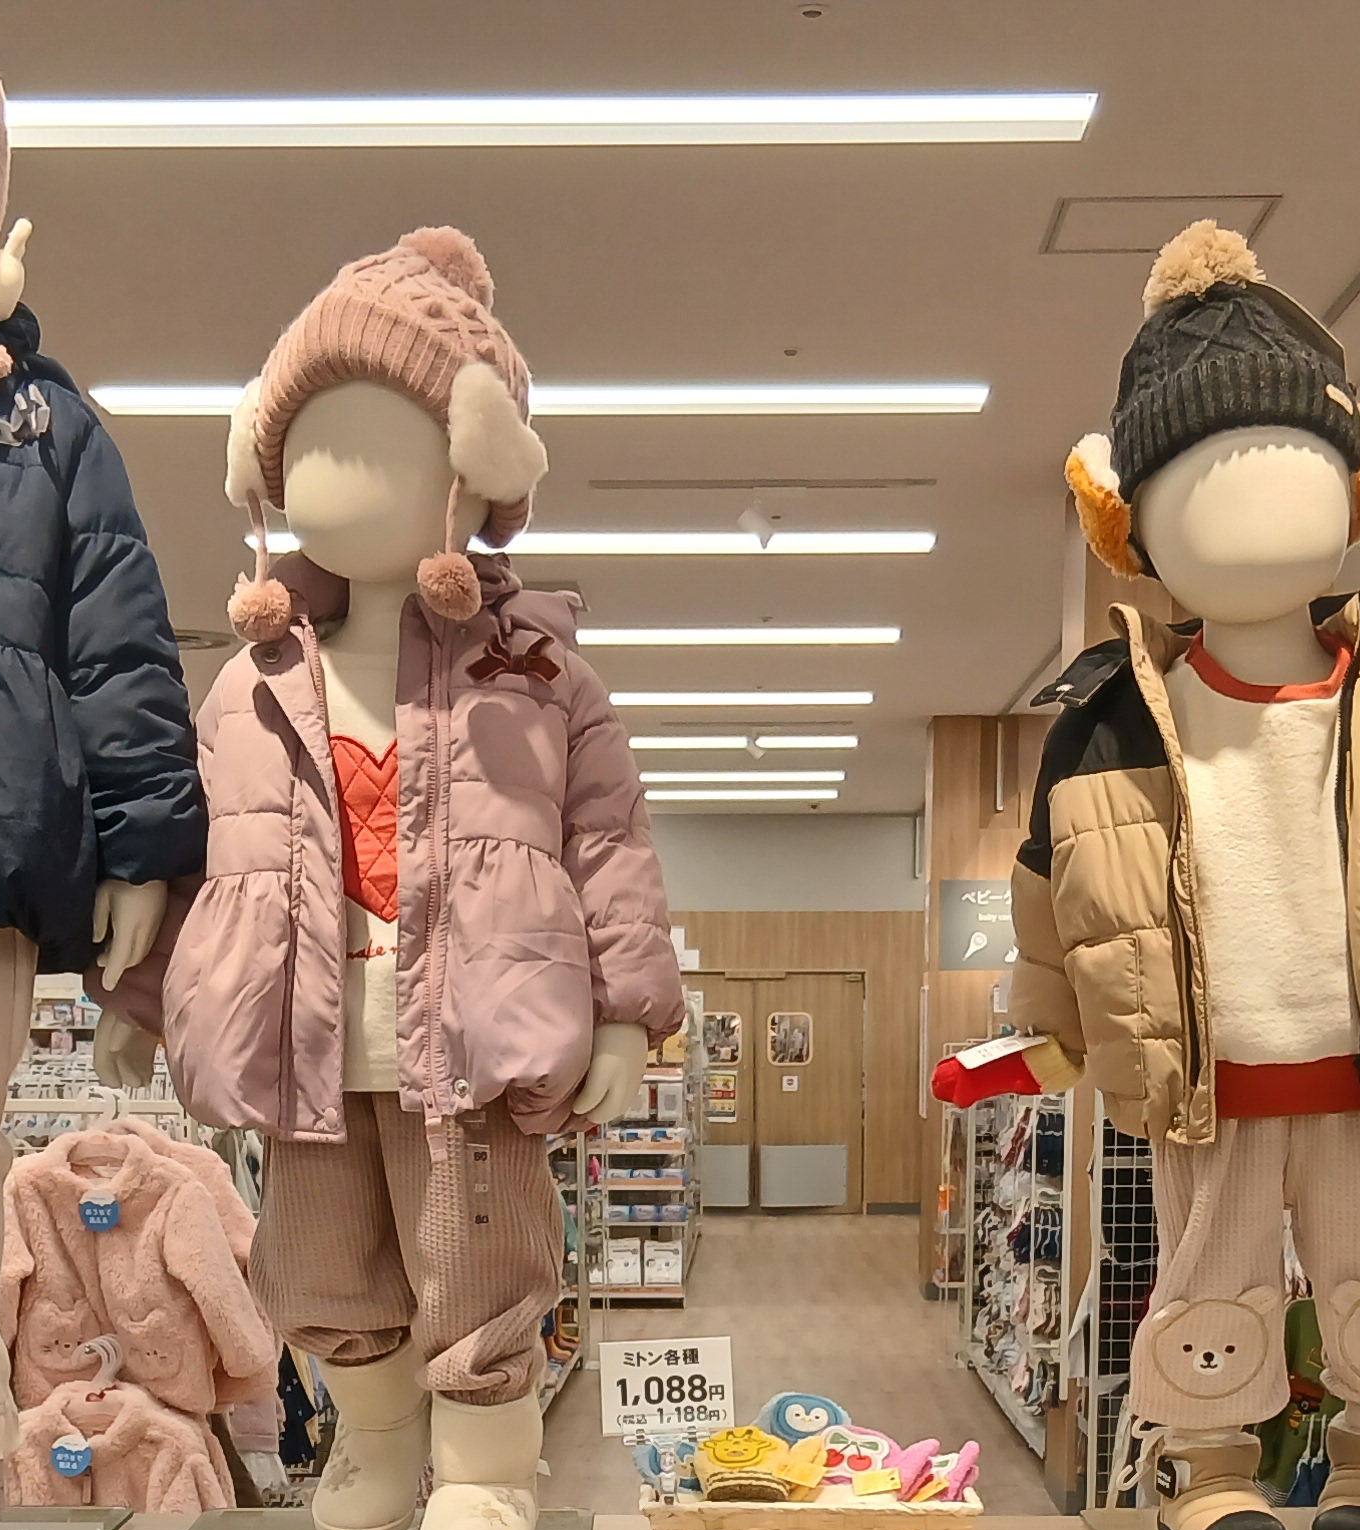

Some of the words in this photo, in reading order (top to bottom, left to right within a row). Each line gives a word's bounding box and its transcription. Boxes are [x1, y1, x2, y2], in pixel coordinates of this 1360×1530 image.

[623, 1348, 700, 1367] ミトン各種
[616, 1374, 725, 1407] 1,088円
